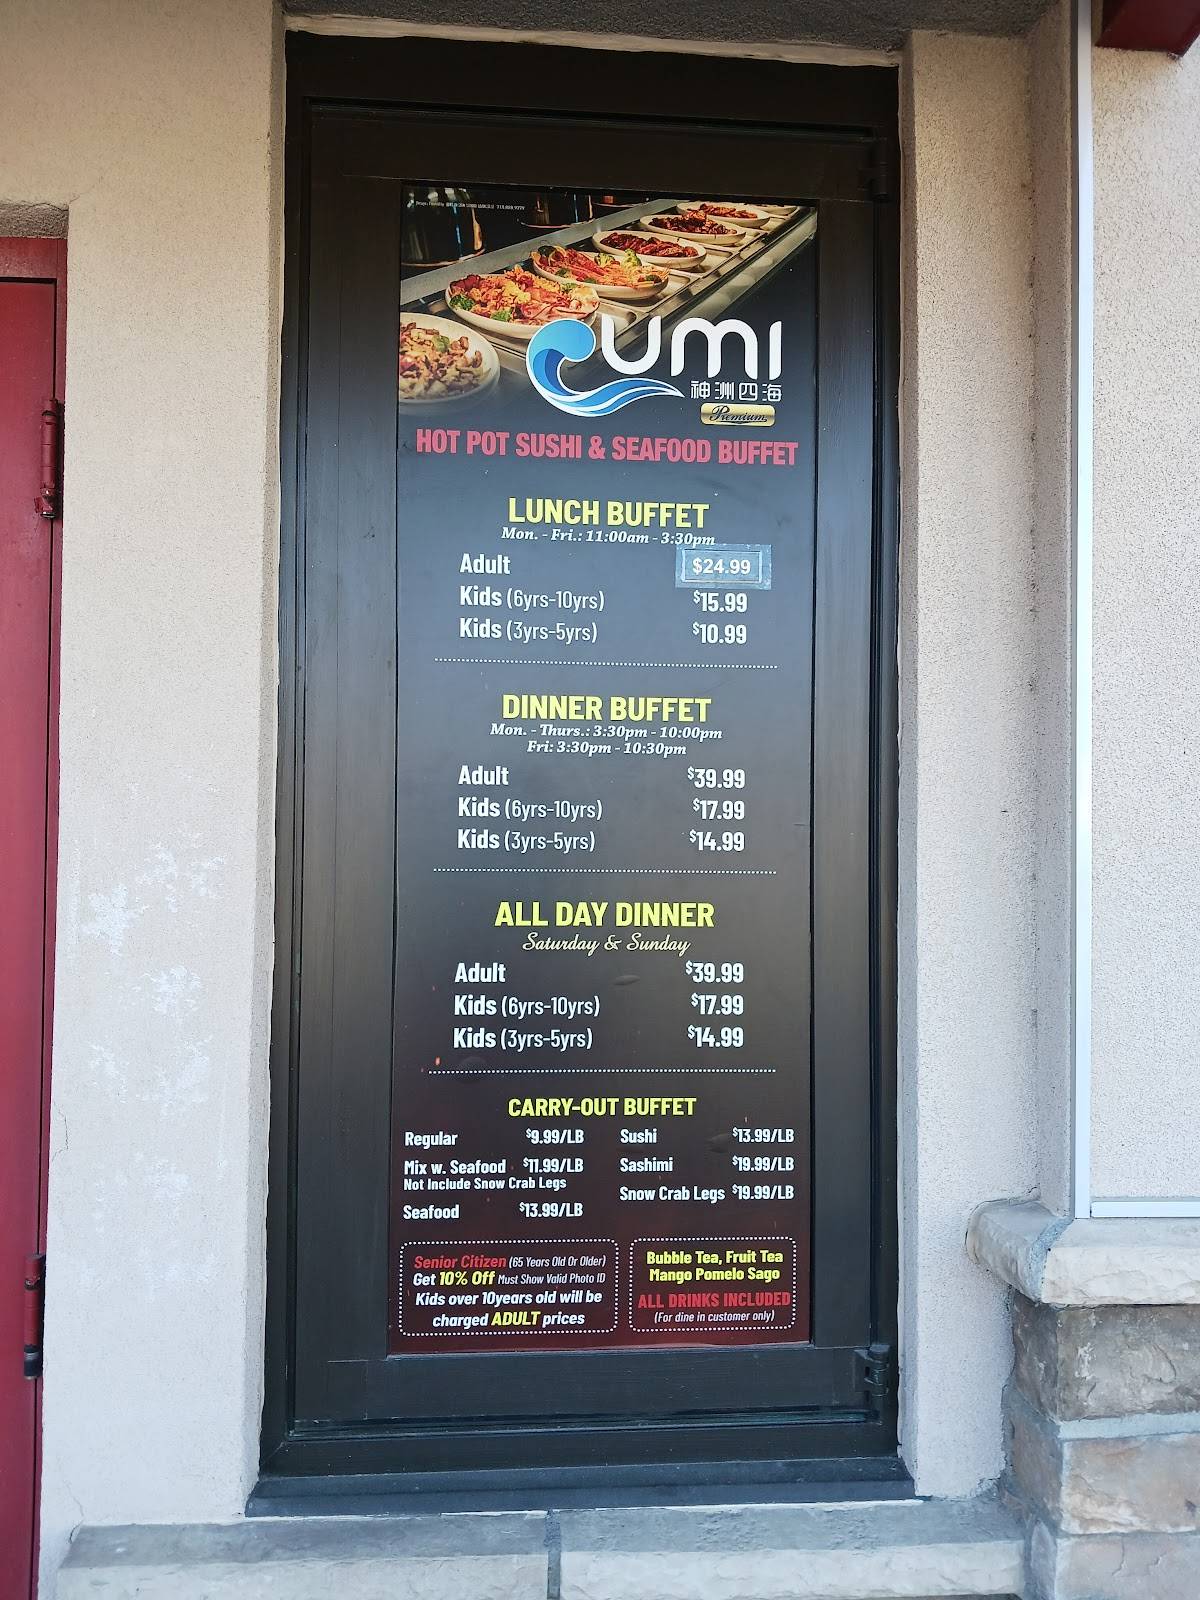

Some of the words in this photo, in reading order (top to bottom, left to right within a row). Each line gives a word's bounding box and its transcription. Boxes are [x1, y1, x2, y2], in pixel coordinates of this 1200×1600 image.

[691, 380, 782, 401] 神洲四海
[710, 405, 767, 424] Premium
[416, 429, 460, 454] HOT
[467, 432, 510, 455] POT
[516, 433, 581, 458] SUSHI
[588, 436, 609, 459] &
[612, 438, 710, 463] SEAFOOD
[718, 441, 798, 465] BUFFET
[508, 498, 600, 526] LUNCH
[607, 502, 709, 528] BUFFET
[501, 527, 538, 541] Mon.
[551, 528, 582, 542] Fri.:
[586, 530, 649, 544] 11:00am
[661, 532, 715, 546] 3:30pm
[460, 554, 510, 574] Adult
[692, 558, 751, 574] $24.99
[460, 586, 502, 606] Kids
[507, 588, 604, 612] (6yrs-10yrs)
[693, 590, 748, 613] $15.99
[460, 618, 502, 638] Kids
[506, 621, 598, 644] (3yrs-5yrs)
[692, 622, 747, 644] $10.99
[503, 695, 602, 720] DINNER
[610, 698, 711, 722] BUFFET
[490, 723, 527, 737] Mon.
[540, 724, 590, 738] Thurs.:
[593, 725, 647, 740] 3:30pm
[660, 726, 722, 740] 10:00pm
[527, 741, 554, 754] Fri:
[557, 742, 611, 756] 3:30pm
[623, 743, 686, 757] 10:30pm
[458, 765, 509, 786] Adult
[688, 766, 745, 788] $39.99
[458, 797, 500, 817] Kids
[504, 798, 602, 822] (6yrs-10yrs)
[693, 799, 745, 820] $17.99
[457, 829, 500, 849] Kids
[504, 830, 595, 853] (3yrs-5yrs)
[689, 830, 745, 851] $14.99
[494, 902, 548, 927] ALL
[556, 902, 609, 927] DAY
[616, 903, 714, 927] DINNER
[522, 932, 600, 956] Saturday
[604, 934, 621, 950] &
[626, 933, 691, 957] Sunday
[455, 962, 506, 984] Adult
[686, 961, 744, 983] $39.99
[455, 995, 497, 1015] Kids
[501, 995, 600, 1018] (6yrs-10yrs)
[691, 993, 744, 1015] $17.99
[454, 1027, 496, 1048] Kids
[500, 1028, 593, 1050] (3yrs-5yrs)
[688, 1025, 744, 1047] $14.99
[508, 1098, 619, 1117] CARRY-OUT
[624, 1098, 696, 1116] BUFFET
[405, 1132, 457, 1149] Regular
[526, 1128, 584, 1145] $9.99/LB
[620, 1128, 657, 1144] Sushi
[732, 1126, 794, 1143] $13.99/LB
[404, 1160, 429, 1176] Mix
[432, 1163, 446, 1175] w.
[450, 1160, 506, 1174] Seafood
[523, 1157, 583, 1174] $11.99/LB
[620, 1158, 673, 1172] Sashimi
[732, 1155, 794, 1171] $19.99/LB
[403, 1178, 425, 1190] Not
[427, 1178, 471, 1190] Include
[474, 1178, 506, 1190] Snow
[508, 1177, 536, 1189] Crab
[539, 1177, 566, 1191] Legs
[732, 1184, 794, 1200] $19.99/LB
[619, 1187, 656, 1201] Snow
[659, 1186, 692, 1200] Crab
[695, 1186, 725, 1203] Legs
[403, 1205, 459, 1219] Seafood
[520, 1202, 583, 1219] $13.99/LB
[414, 1256, 458, 1268] Senior
[461, 1254, 507, 1268] Citizen
[509, 1257, 524, 1268] (65
[526, 1257, 550, 1267] Years
[552, 1256, 566, 1267] Old
[568, 1256, 578, 1266] Or
[580, 1255, 606, 1267] Older)
[647, 1251, 691, 1265] Bubble
[695, 1251, 723, 1266] Tea,
[726, 1250, 756, 1263] Fruit
[759, 1250, 783, 1263] Tea
[413, 1273, 436, 1286] Get
[439, 1272, 468, 1285] 10%
[472, 1271, 495, 1285] Off
[498, 1274, 518, 1284] Must
[521, 1274, 544, 1284] Show
[546, 1273, 567, 1283] Valid
[569, 1273, 594, 1283] Photo
[597, 1273, 605, 1283] ID
[649, 1268, 693, 1285] Mango
[696, 1267, 745, 1280] Pomelo
[748, 1267, 780, 1284] Sago
[416, 1292, 446, 1305] Kids
[449, 1293, 479, 1304] over
[482, 1292, 532, 1307] 10years
[536, 1291, 558, 1304] old
[560, 1290, 583, 1303] will
[585, 1291, 602, 1303] be
[638, 1294, 664, 1309] ALL
[669, 1293, 719, 1308] DRINKS
[723, 1292, 791, 1307] INCLUDED
[433, 1313, 489, 1329] charged
[491, 1311, 541, 1326] ADULT
[542, 1312, 585, 1327] prices
[654, 1311, 673, 1324] (For
[675, 1311, 694, 1322] dine
[697, 1311, 705, 1322] in
[708, 1311, 750, 1322] customer
[752, 1309, 775, 1323] only)
